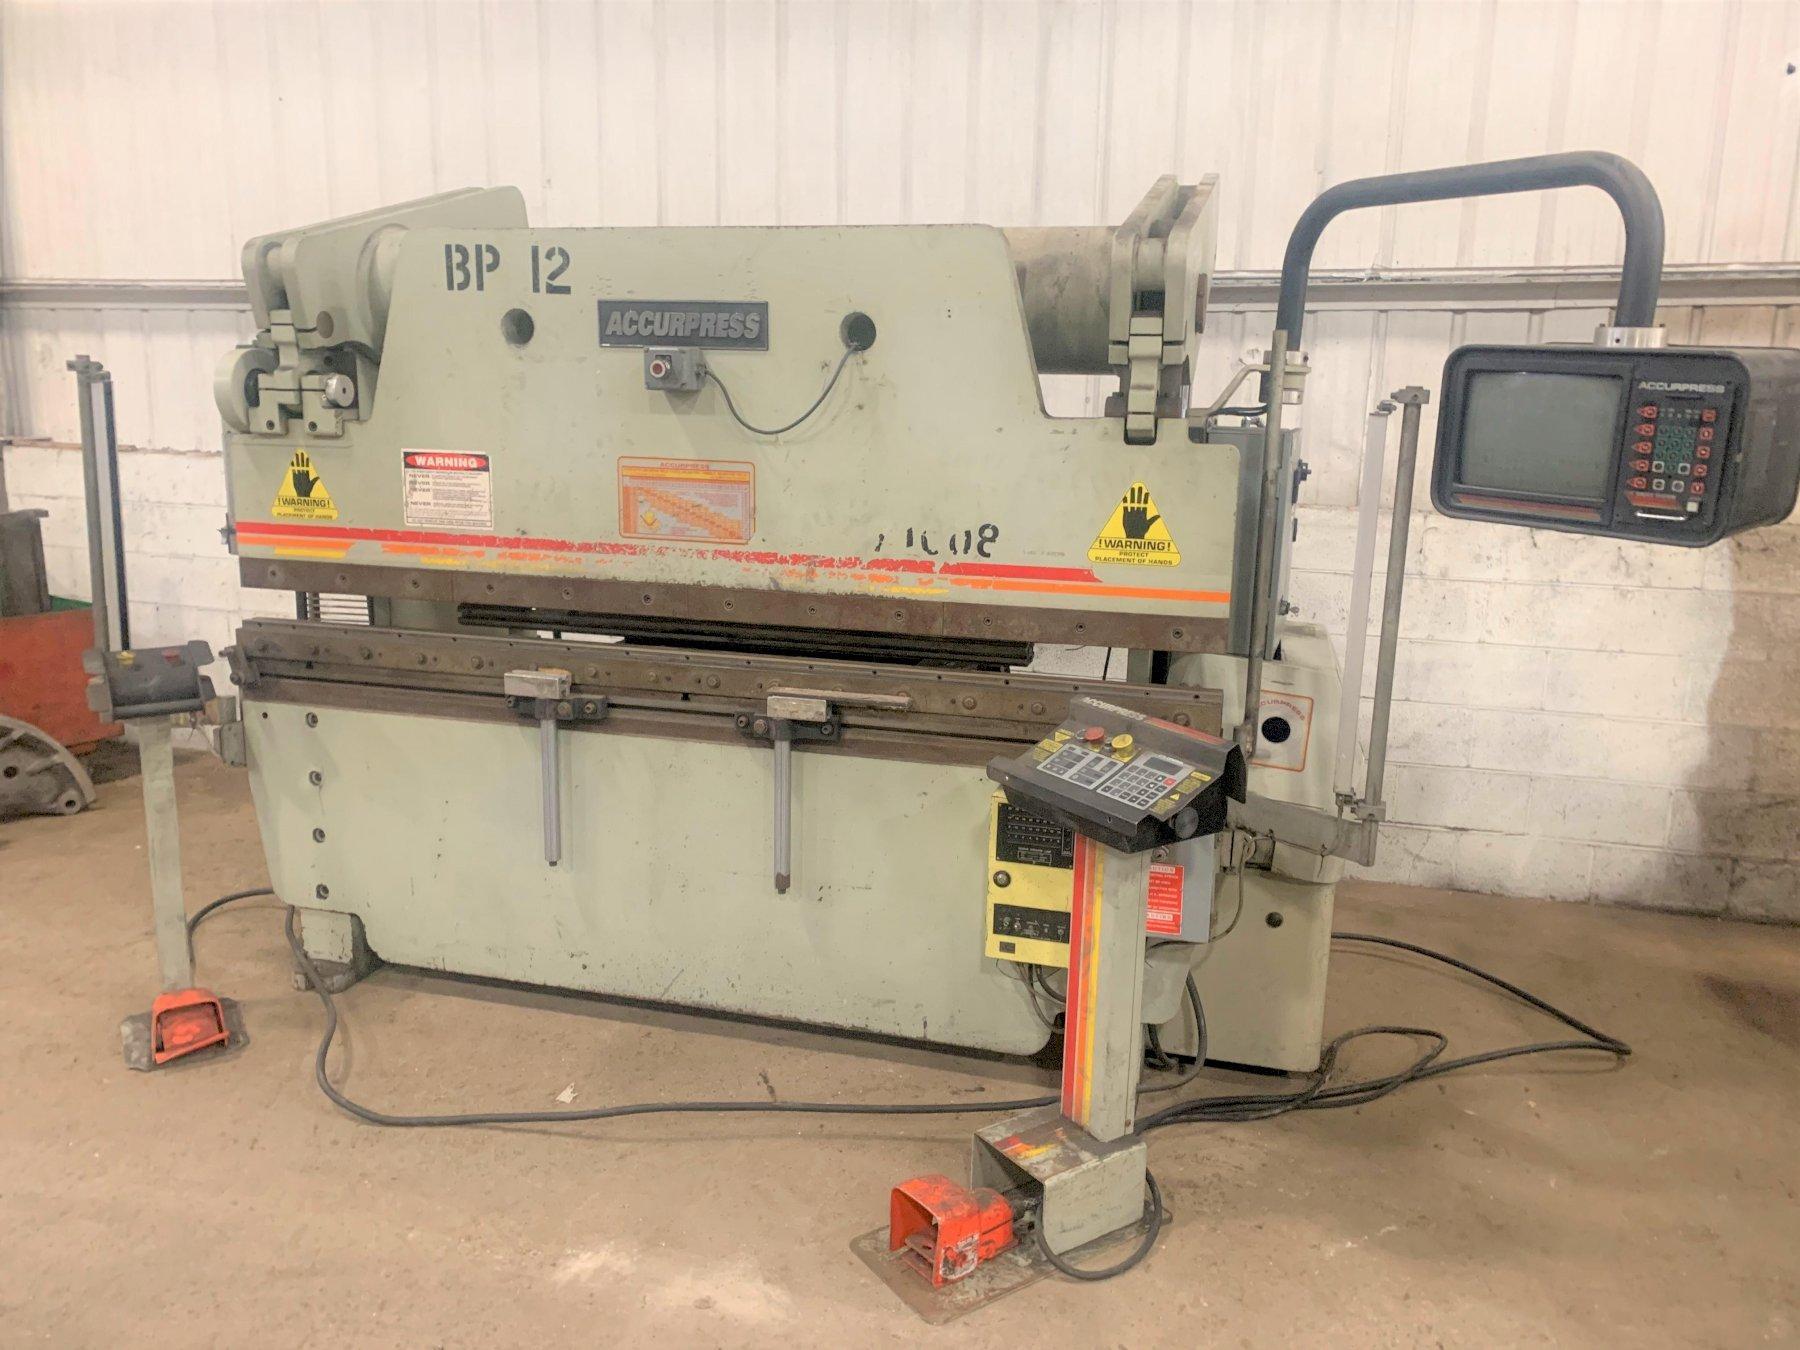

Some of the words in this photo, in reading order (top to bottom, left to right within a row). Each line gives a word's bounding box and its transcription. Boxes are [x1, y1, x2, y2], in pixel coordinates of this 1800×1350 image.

[444, 243, 500, 292] BP
[530, 245, 572, 294] 12
[605, 311, 760, 340] ACCURPRESS
[1639, 382, 1724, 393] ACCURPRESS
[414, 456, 478, 468] WARNING
